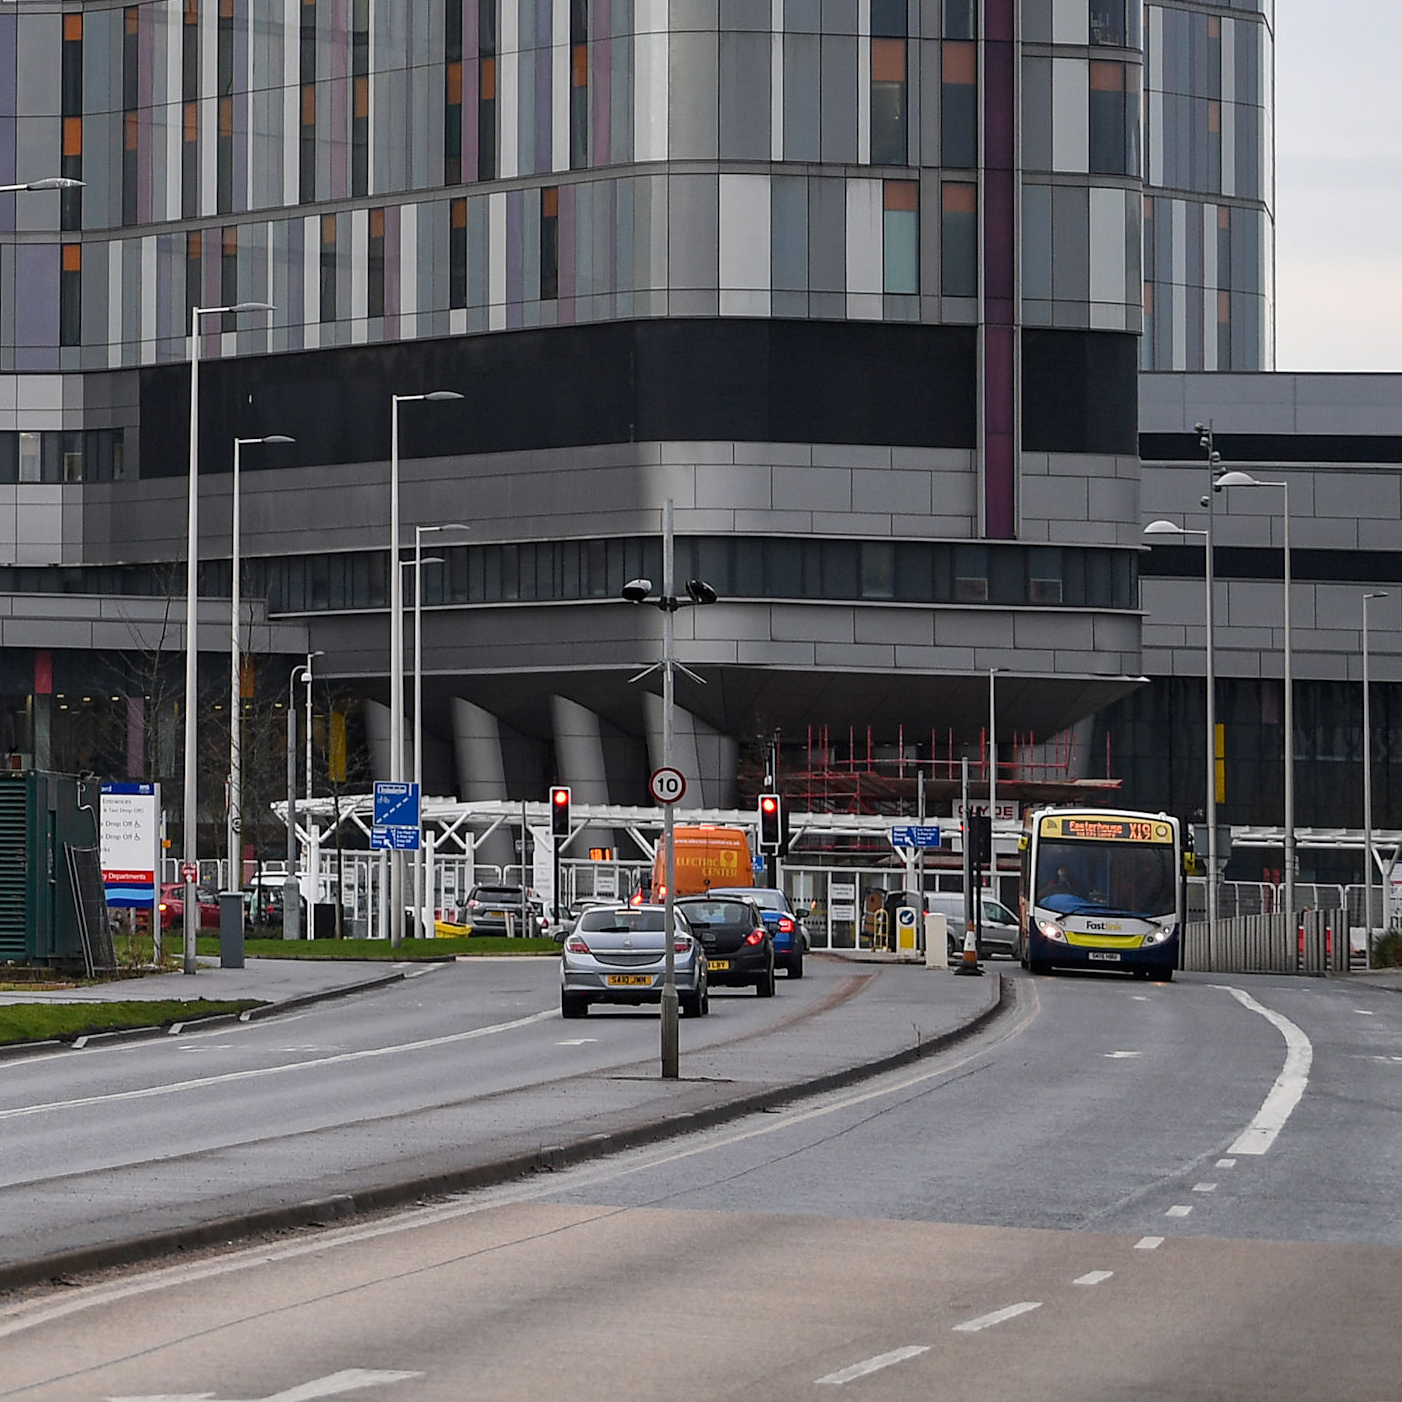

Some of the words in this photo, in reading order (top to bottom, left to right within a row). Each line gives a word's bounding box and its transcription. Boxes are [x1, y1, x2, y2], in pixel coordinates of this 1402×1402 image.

[657, 778, 678, 793] 10
[1129, 823, 1151, 840] X19
[676, 858, 719, 866] ELECTRIC
[108, 873, 147, 881] Departments
[702, 868, 737, 877] CENTER
[1086, 920, 1123, 931] Fastlink
